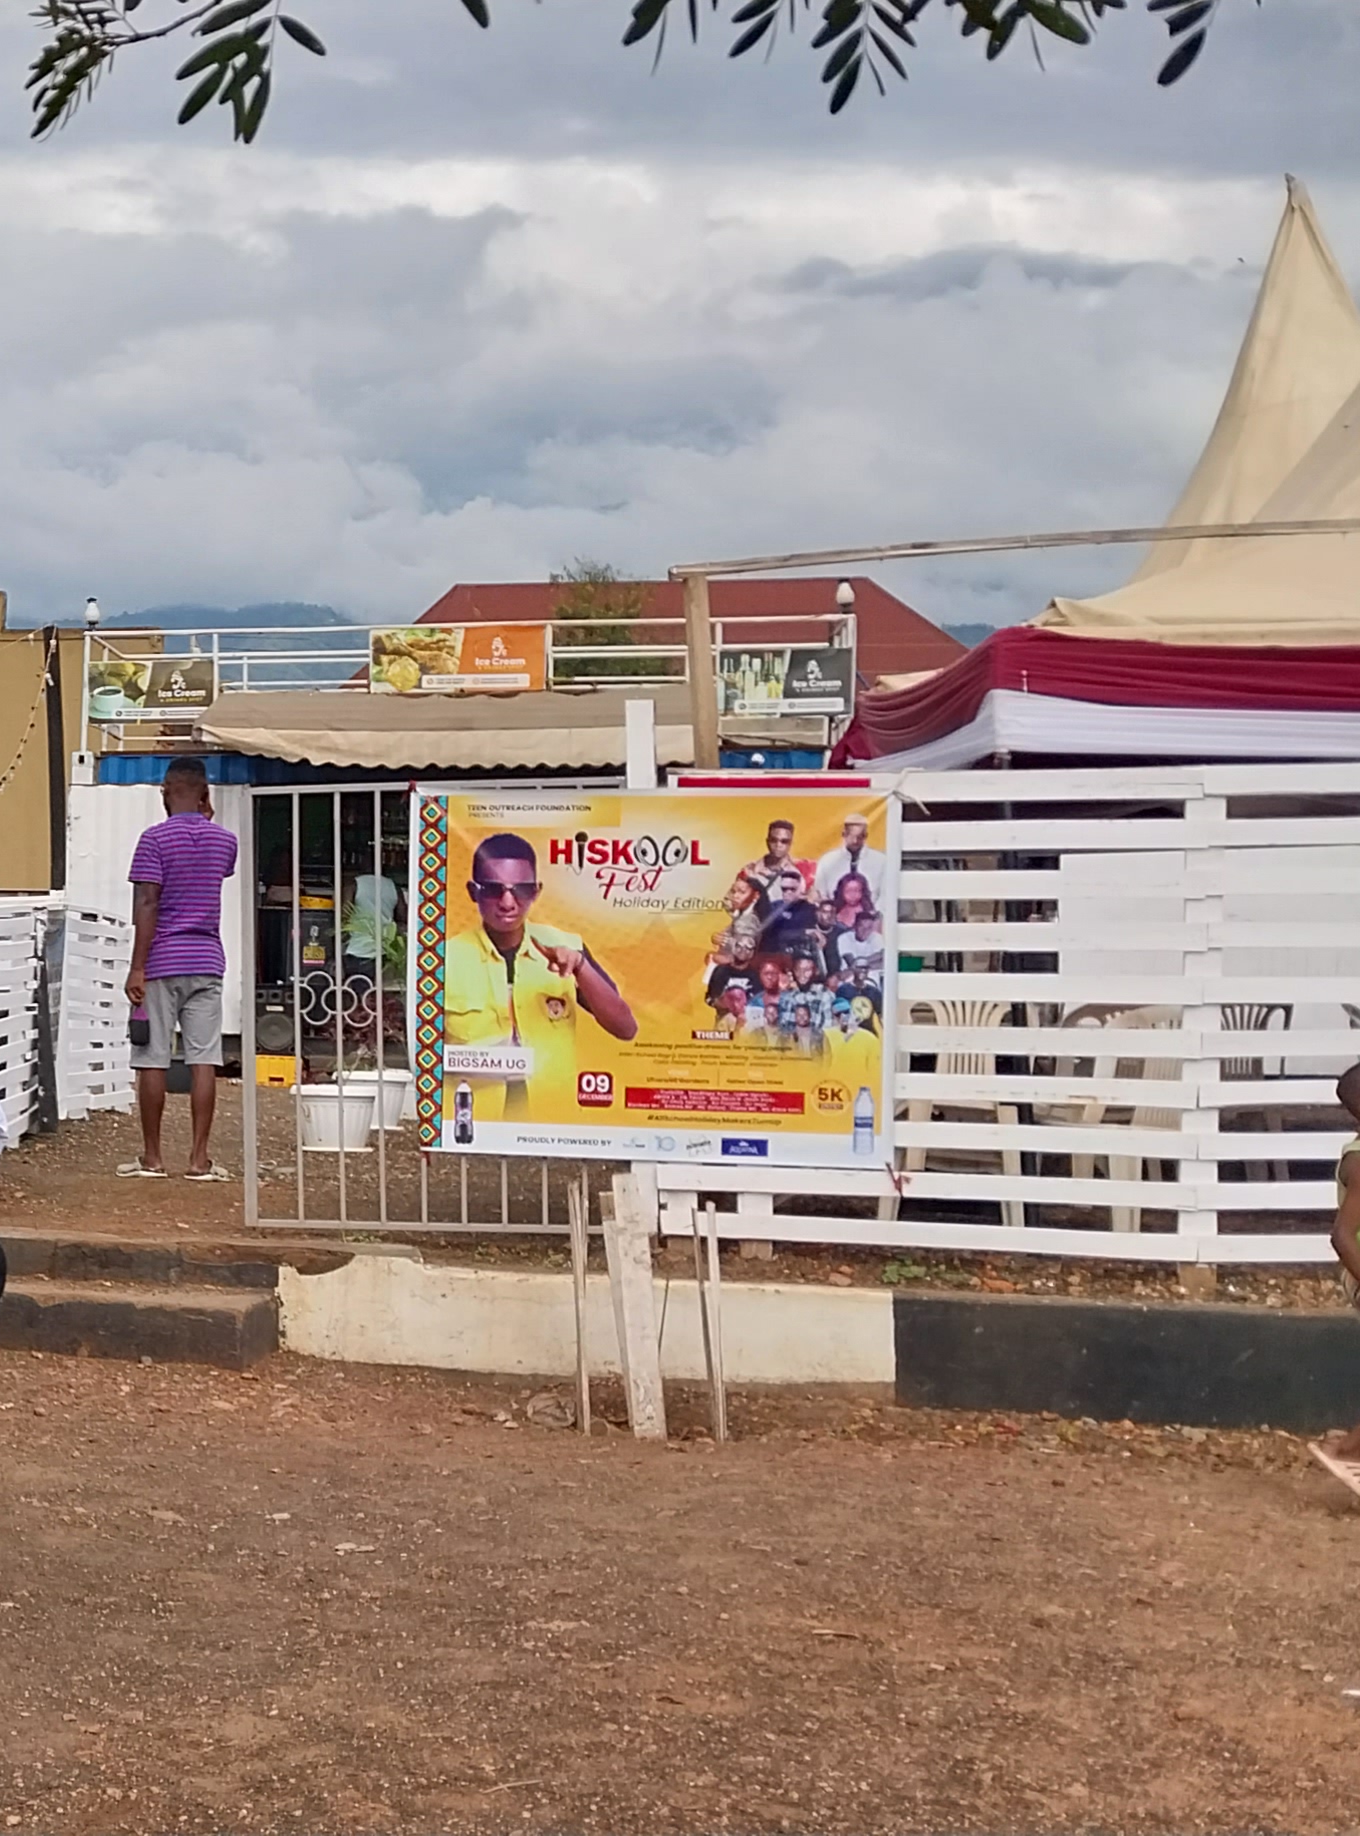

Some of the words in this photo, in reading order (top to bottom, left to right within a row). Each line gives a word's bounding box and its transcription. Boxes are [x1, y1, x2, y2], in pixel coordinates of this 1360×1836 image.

[491, 657, 526, 666] Cream
[808, 679, 842, 688] Cream
[173, 689, 206, 698] Cream
[488, 804, 534, 812] OUTREACH
[595, 865, 673, 900] Fest
[613, 896, 669, 911] Holiday
[673, 897, 726, 910] Edition
[695, 1031, 730, 1040] THEME
[448, 1057, 502, 1069] BIGSAM
[506, 1059, 526, 1070] UG
[581, 1074, 610, 1093] 09
[818, 1087, 843, 1102] 5K
[517, 1136, 555, 1145] PROUDLY
[557, 1137, 599, 1146] POWERED
